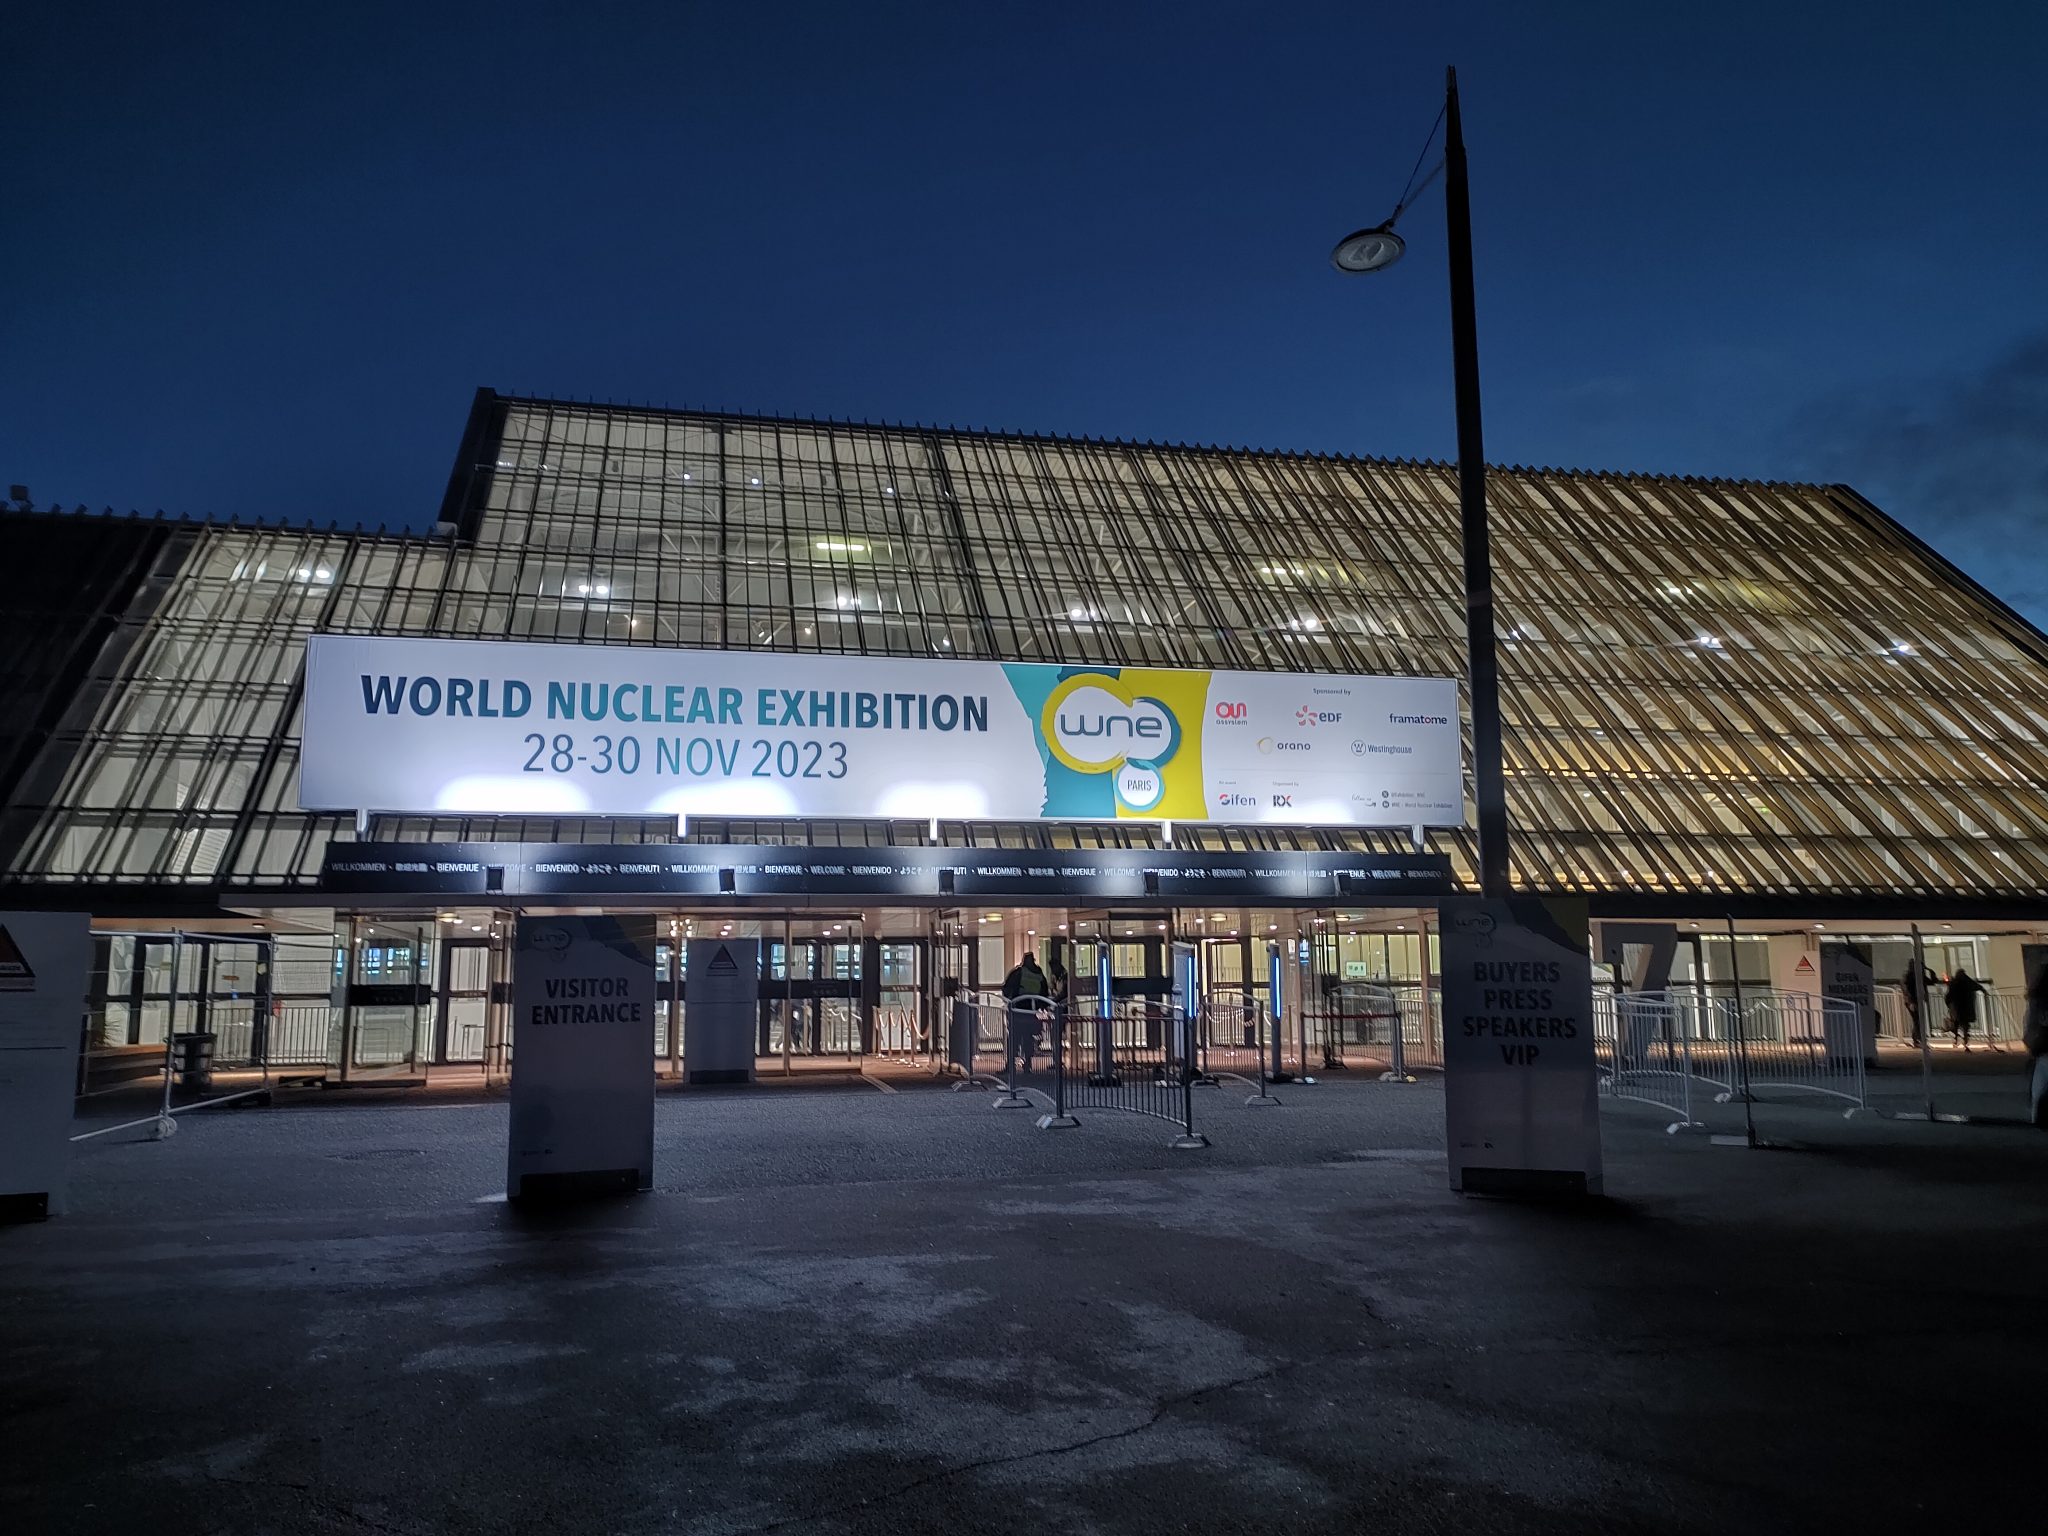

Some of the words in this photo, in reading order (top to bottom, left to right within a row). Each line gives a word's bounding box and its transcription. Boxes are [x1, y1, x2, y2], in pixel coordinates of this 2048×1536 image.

[361, 674, 532, 718] WORLD
[547, 682, 743, 725] NUCLEAR
[757, 688, 989, 732] EXHIBITION
[1313, 688, 1343, 696] Sponsored
[1344, 688, 1351, 697] by
[1060, 713, 1163, 738] wne
[1389, 713, 1448, 725] framatome
[522, 733, 641, 775] 28-30
[656, 736, 741, 777] NOV
[751, 739, 849, 779] 2023
[1277, 743, 1311, 751] orano
[1368, 744, 1413, 755] Westinghouse
[1127, 779, 1152, 792] PARIS
[331, 862, 386, 872] WILLKOMMEN
[436, 863, 480, 873] BIENVENUE
[535, 863, 580, 874] BIENVENIDO
[619, 864, 660, 875] BENVENUTI
[671, 864, 720, 874] WILLKOMMEN
[765, 865, 803, 875] BIENVENUE
[810, 865, 845, 876] WELCOME
[852, 866, 892, 876] BIENVENIDO
[977, 866, 1022, 877] WILLKOMMEN
[1061, 867, 1096, 877] BIENVENUE
[1104, 867, 1136, 877] WELCOME
[1211, 868, 1247, 879] BENVENUTI
[1473, 961, 1561, 984] BUYERS
[545, 977, 629, 998] VISITOR
[1484, 988, 1553, 1011] PRESS
[531, 1002, 641, 1025] ENTRANCE
[1462, 1016, 1577, 1039] SPEAKERS
[1500, 1043, 1540, 1066] VIP
